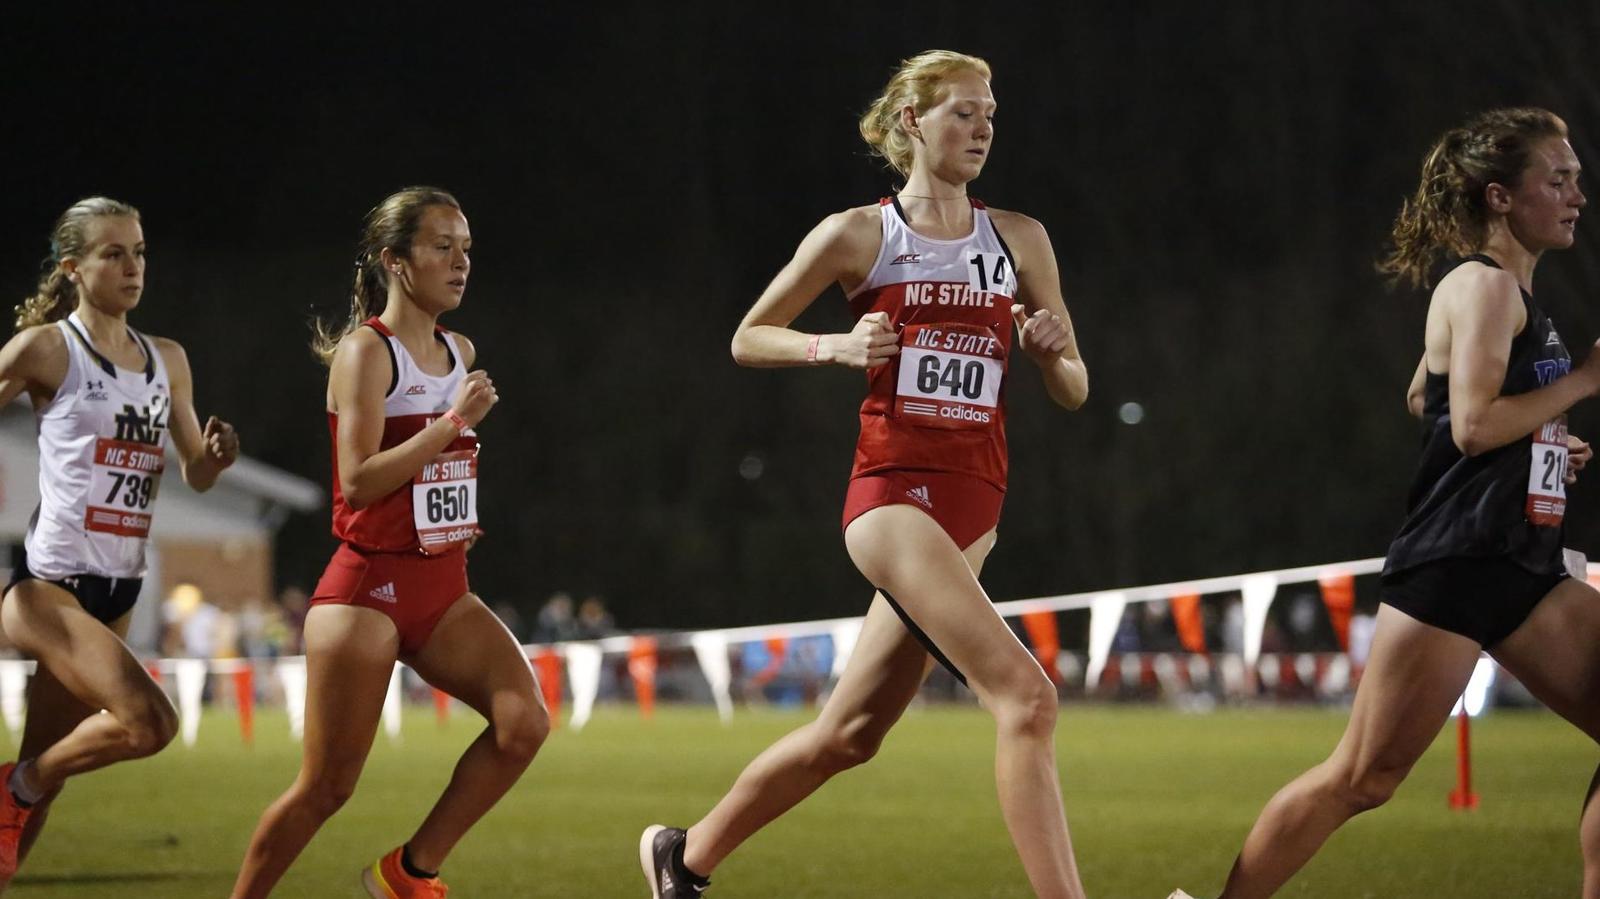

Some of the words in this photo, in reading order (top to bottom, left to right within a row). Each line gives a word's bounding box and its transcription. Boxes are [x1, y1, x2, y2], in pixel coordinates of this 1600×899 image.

[890, 254, 920, 265] ACC
[970, 253, 1007, 291] 14
[905, 283, 933, 307] NC
[938, 284, 995, 308] STATE
[915, 328, 942, 348] NC
[943, 333, 996, 356] STATE
[917, 355, 984, 399] 640
[84, 391, 109, 401] ACC
[405, 385, 426, 395] ACC
[940, 405, 990, 423] adidas
[104, 448, 126, 466] NC
[422, 464, 438, 481] NC
[442, 459, 471, 479] STATE
[104, 471, 153, 510] 739
[426, 484, 469, 524] 650
